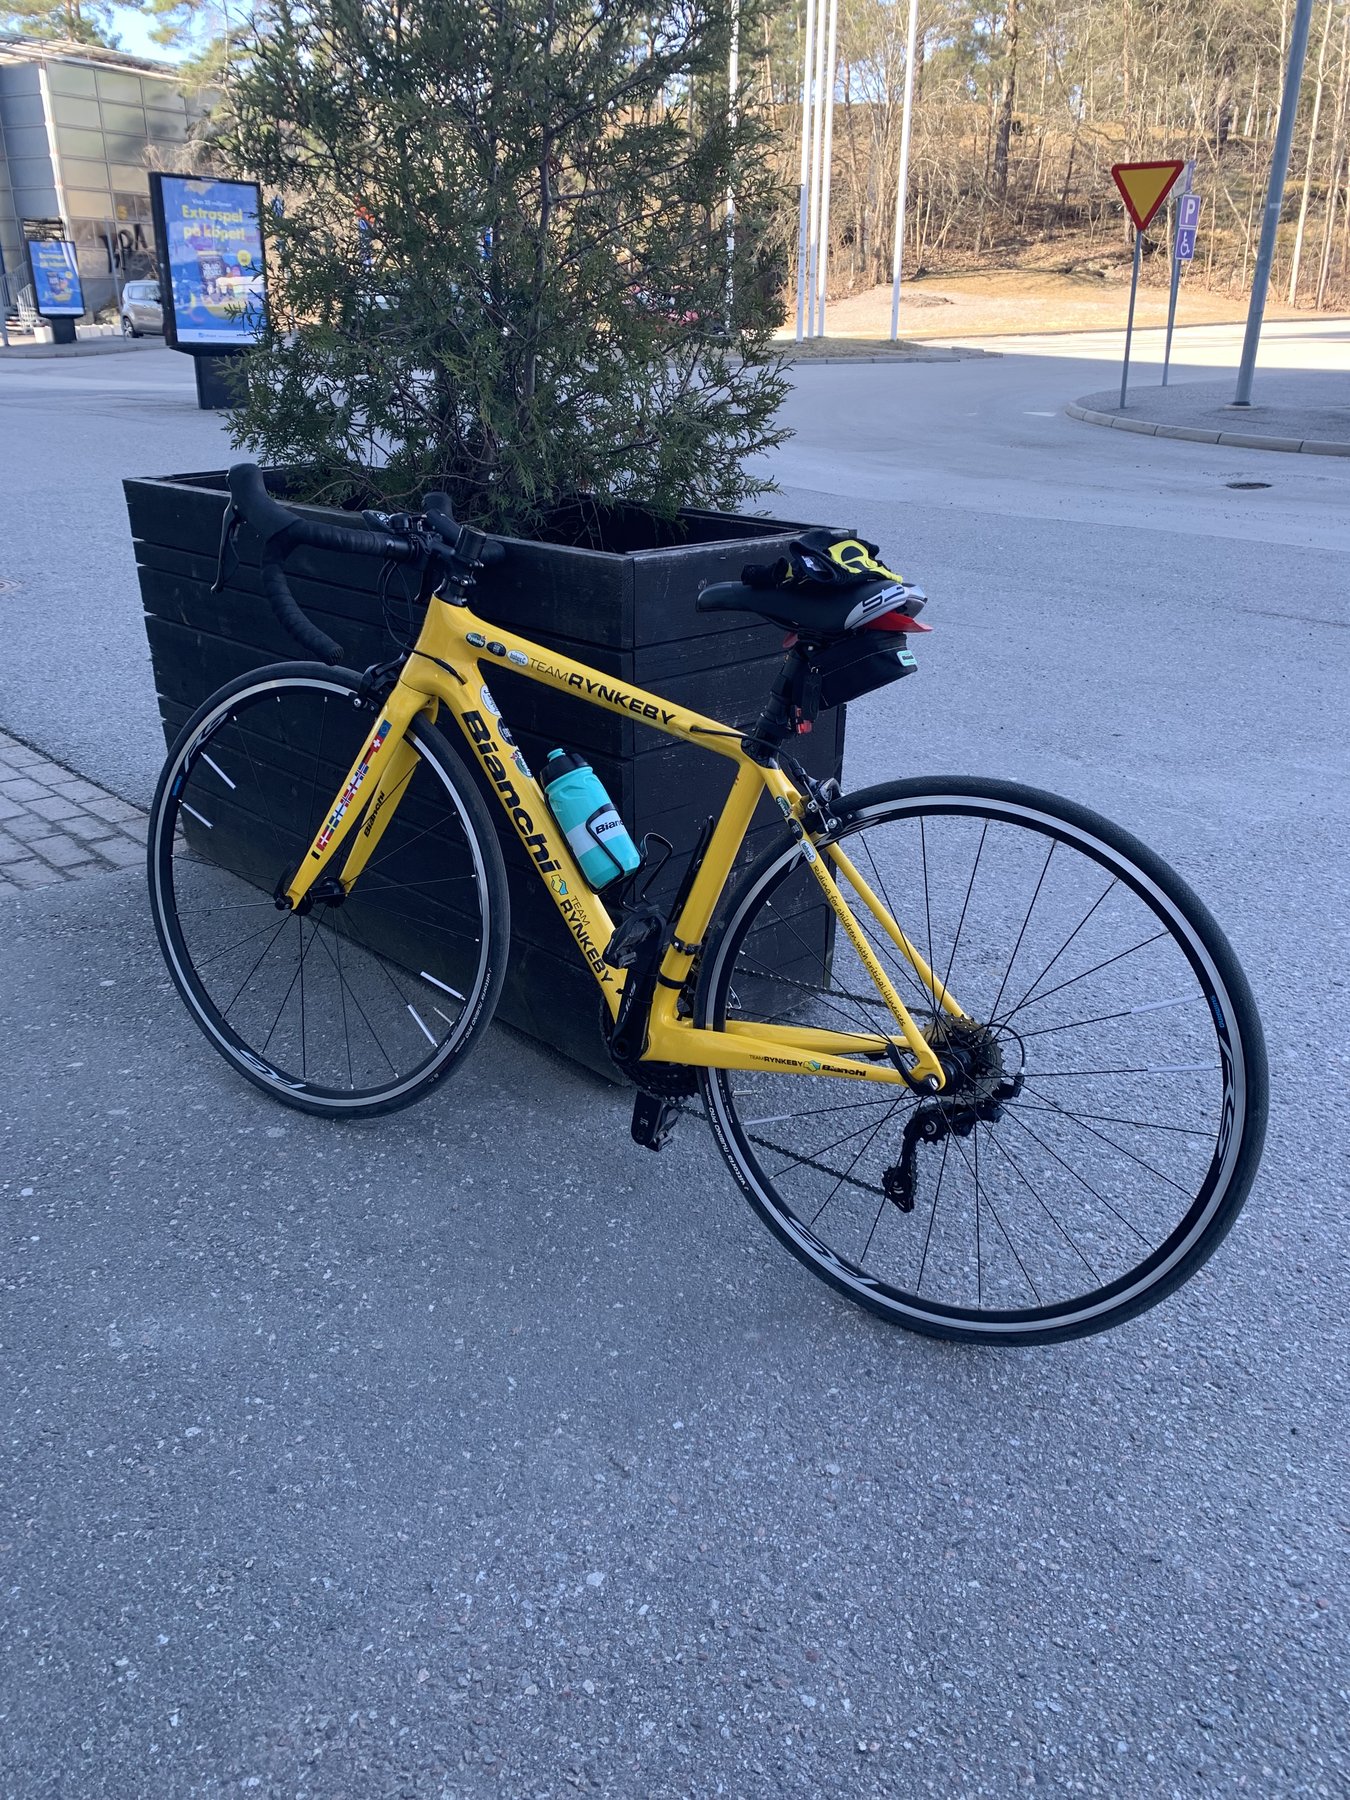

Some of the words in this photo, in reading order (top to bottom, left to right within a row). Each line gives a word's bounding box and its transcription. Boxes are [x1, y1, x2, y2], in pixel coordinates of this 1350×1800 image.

[181, 205, 243, 223] Extraspel
[1185, 199, 1196, 224] P
[461, 710, 561, 874] Bianchi
[363, 790, 385, 838] Bianchi
[570, 895, 590, 927] TEAM
[559, 899, 614, 983] RYNKEBY
[813, 865, 832, 895] Riding
[829, 895, 839, 907] for
[837, 908, 857, 942] children
[856, 941, 869, 960] with
[866, 961, 886, 991] critical
[883, 989, 906, 1027] illnesses
[821, 1064, 867, 1077] Bianchi
